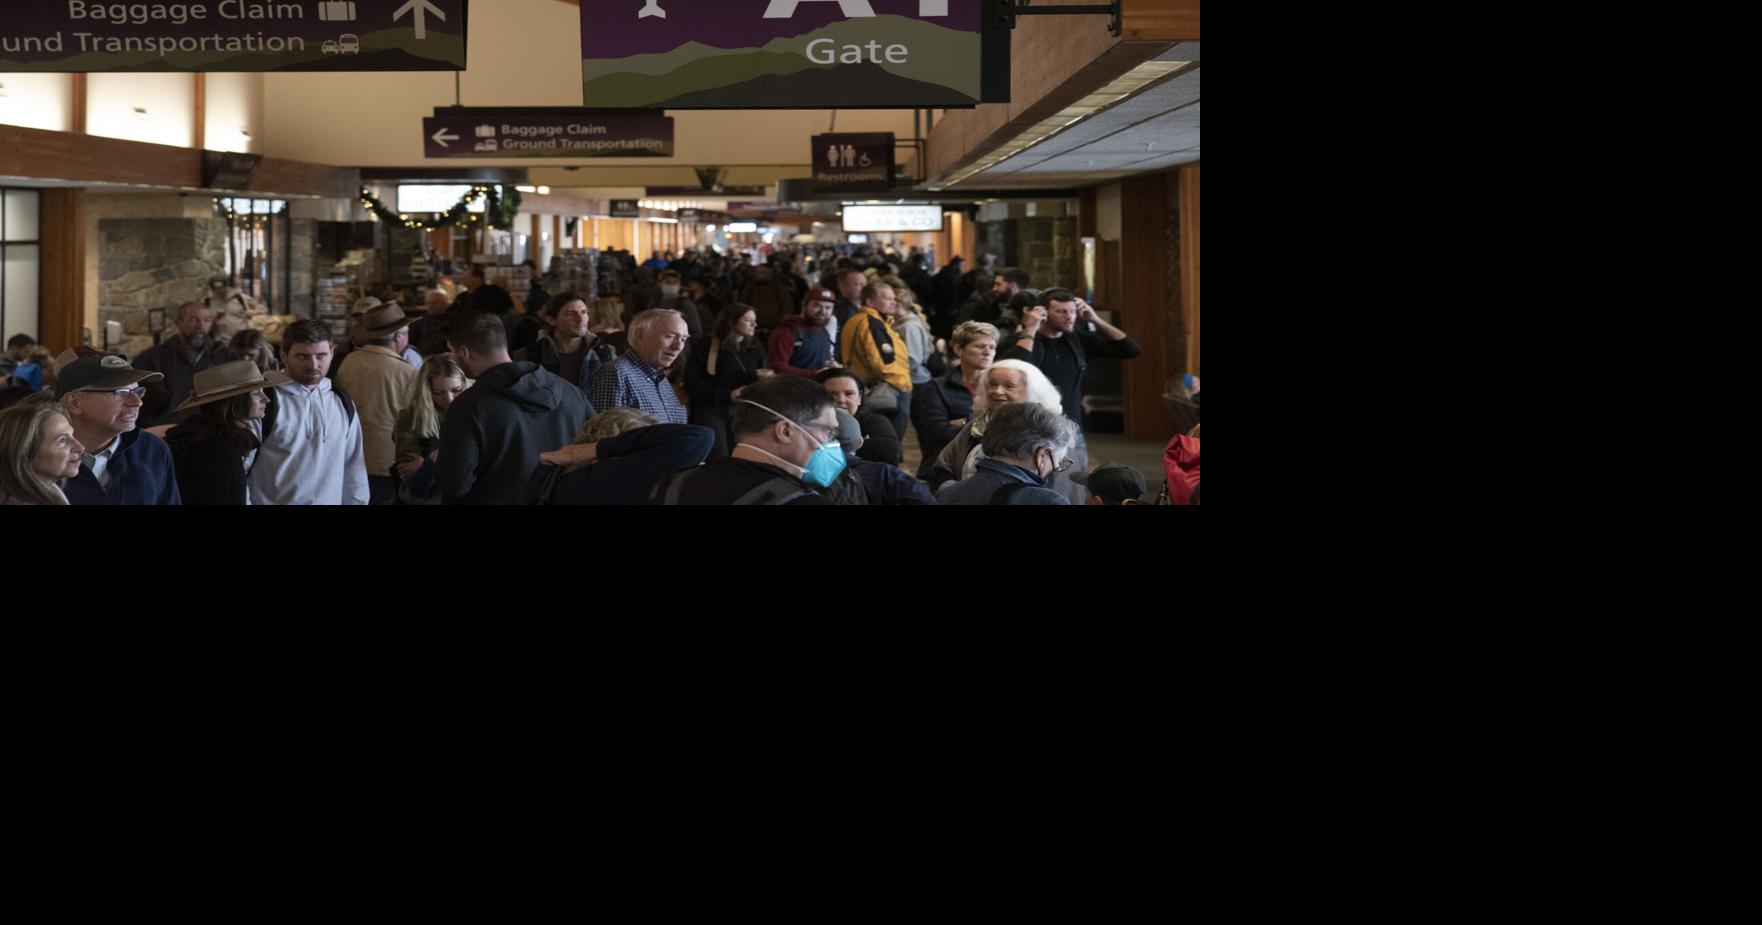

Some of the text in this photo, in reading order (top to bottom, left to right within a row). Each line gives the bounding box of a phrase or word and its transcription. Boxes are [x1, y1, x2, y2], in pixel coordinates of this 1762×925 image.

[68, 0, 304, 25] Baggage Claim
[73, 32, 305, 56] Transportation
[805, 38, 909, 65] Gate
[502, 124, 607, 137] Baggage Claim
[502, 138, 663, 151] Ground Transportation
[818, 172, 883, 182] Restrooms
